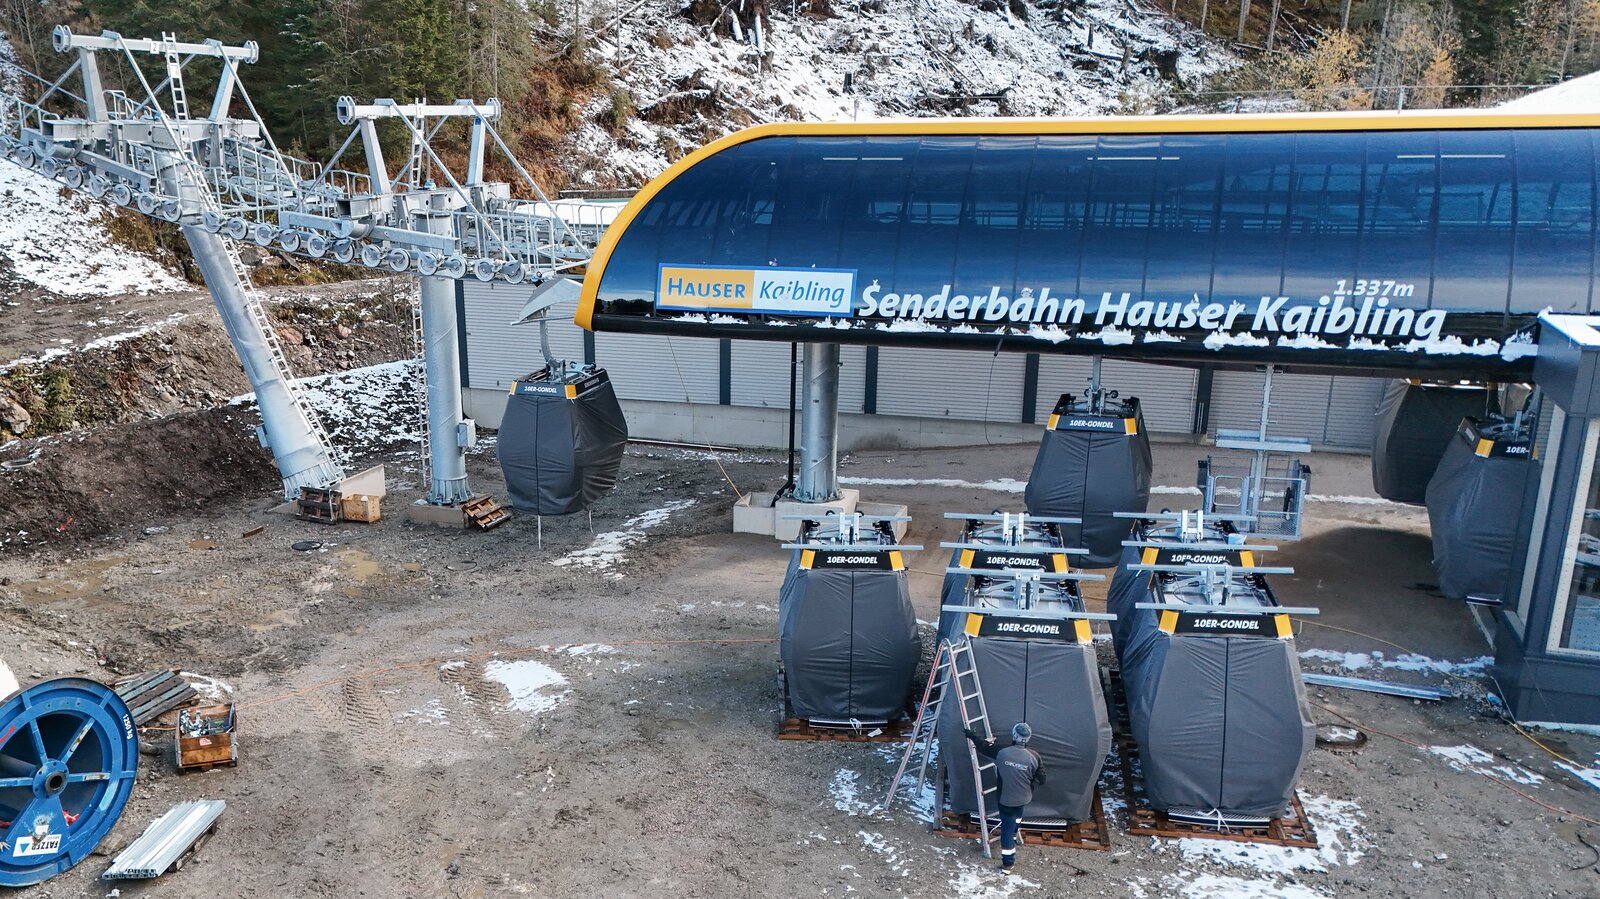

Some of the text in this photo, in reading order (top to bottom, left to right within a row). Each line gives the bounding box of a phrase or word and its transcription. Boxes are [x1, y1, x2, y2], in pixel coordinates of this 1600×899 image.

[667, 277, 845, 308] HAUSER Kaibling
[1333, 279, 1415, 297] 1.337m
[859, 284, 1448, 342] Senderbahn Hauser Kaibling
[1069, 419, 1114, 428] 10ER-GONDEL
[826, 556, 878, 564] 10ER-GONDEL
[986, 556, 1040, 566] 10ER-GONDEL
[996, 622, 1060, 634] 10ER-GONDEL
[1193, 619, 1260, 630] 10ER-GONDEL
[122, 713, 134, 740] 1250 kg
